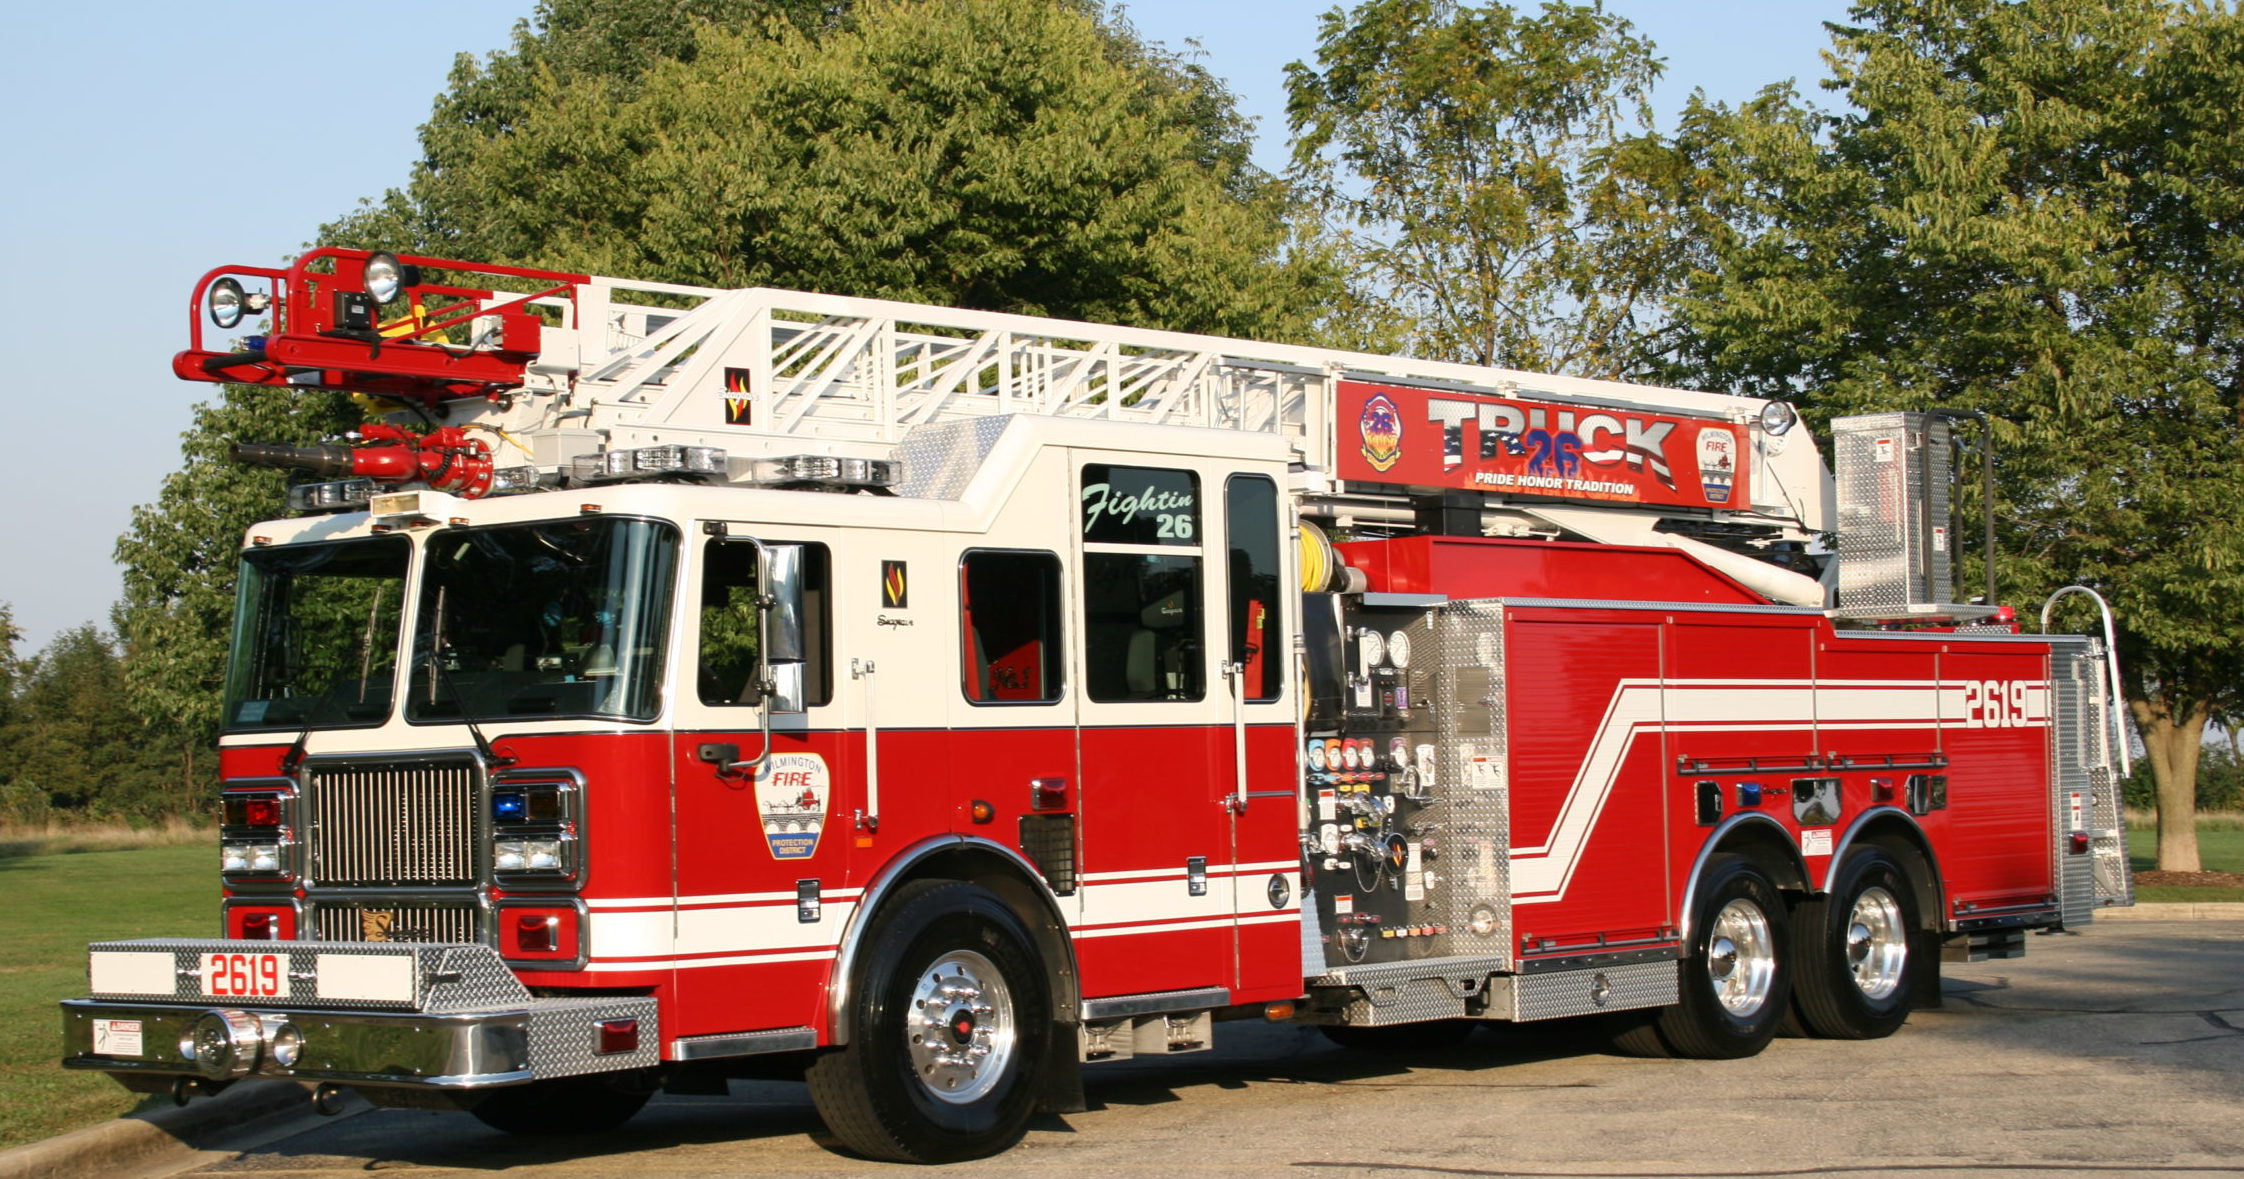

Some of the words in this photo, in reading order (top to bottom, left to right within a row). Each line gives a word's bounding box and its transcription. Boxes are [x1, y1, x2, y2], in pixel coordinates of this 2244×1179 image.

[1371, 412, 1394, 433] 26
[1526, 429, 1582, 479] 26
[1706, 441, 1728, 452] FIRE
[1475, 472, 1514, 487] PRIDE
[1517, 475, 1563, 490] HONOR
[1566, 478, 1635, 495] TRADITION
[1082, 483, 1194, 533] Fightin
[1156, 514, 1193, 538] 26
[1966, 680, 2027, 728] 2619
[764, 756, 822, 774] WILMINGTON
[772, 772, 813, 786] FIRE
[211, 954, 278, 996] 2619
